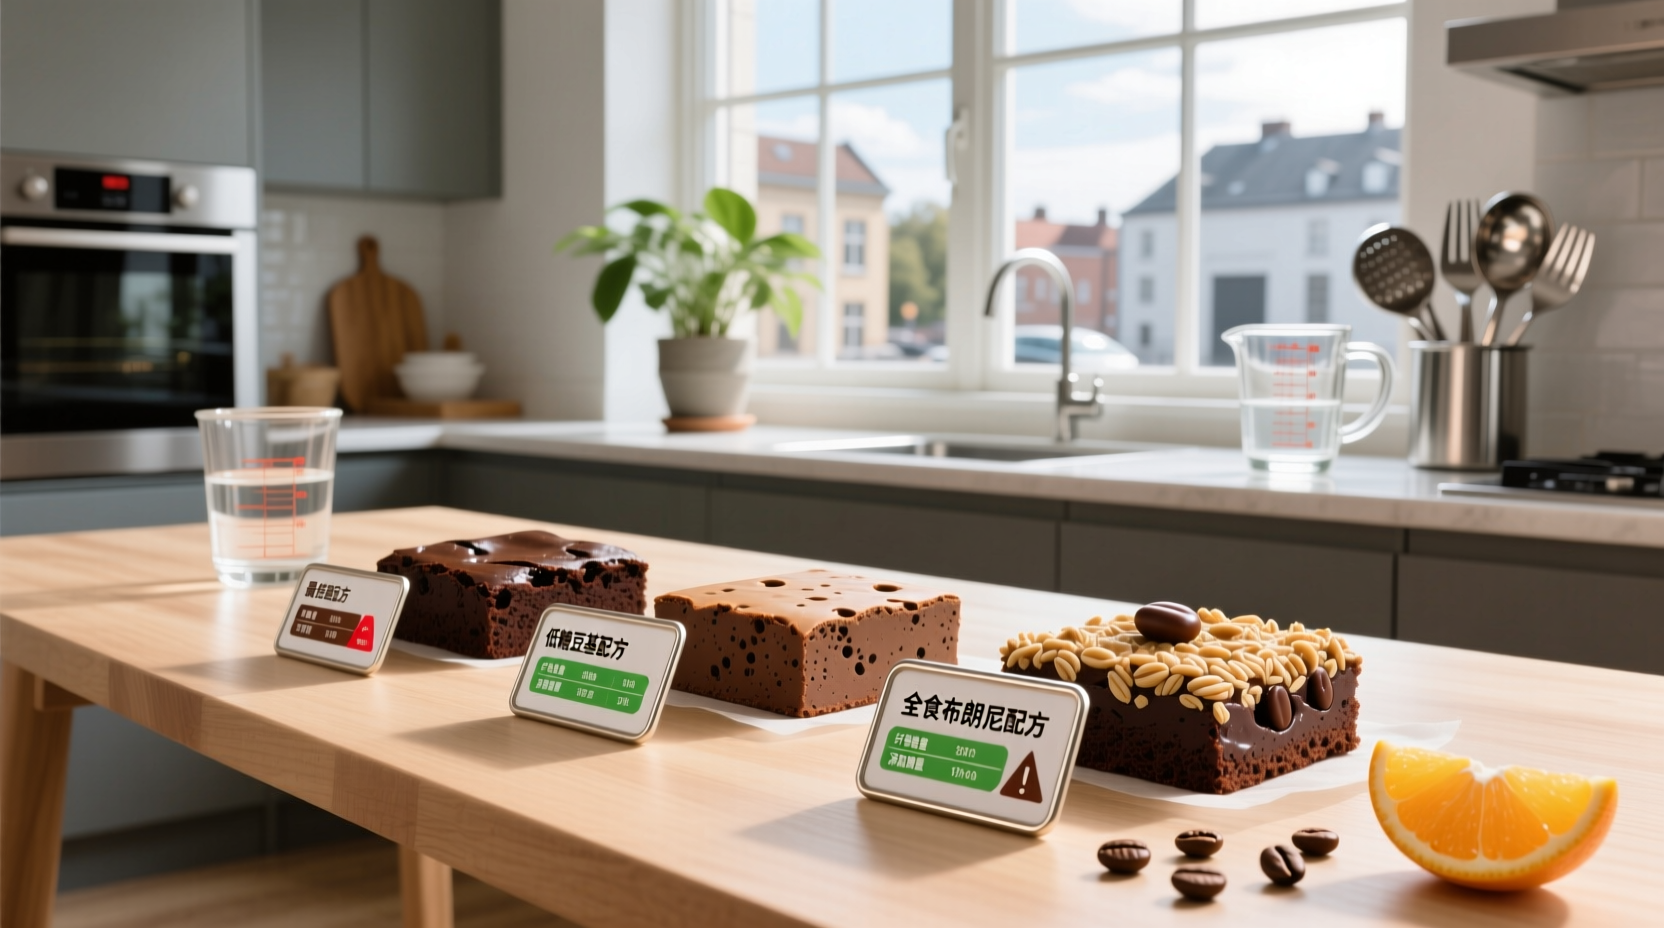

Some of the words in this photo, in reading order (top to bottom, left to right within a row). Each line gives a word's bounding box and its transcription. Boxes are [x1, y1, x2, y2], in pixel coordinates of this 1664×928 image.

[901, 691, 1050, 739] 全食布朗尼配方
